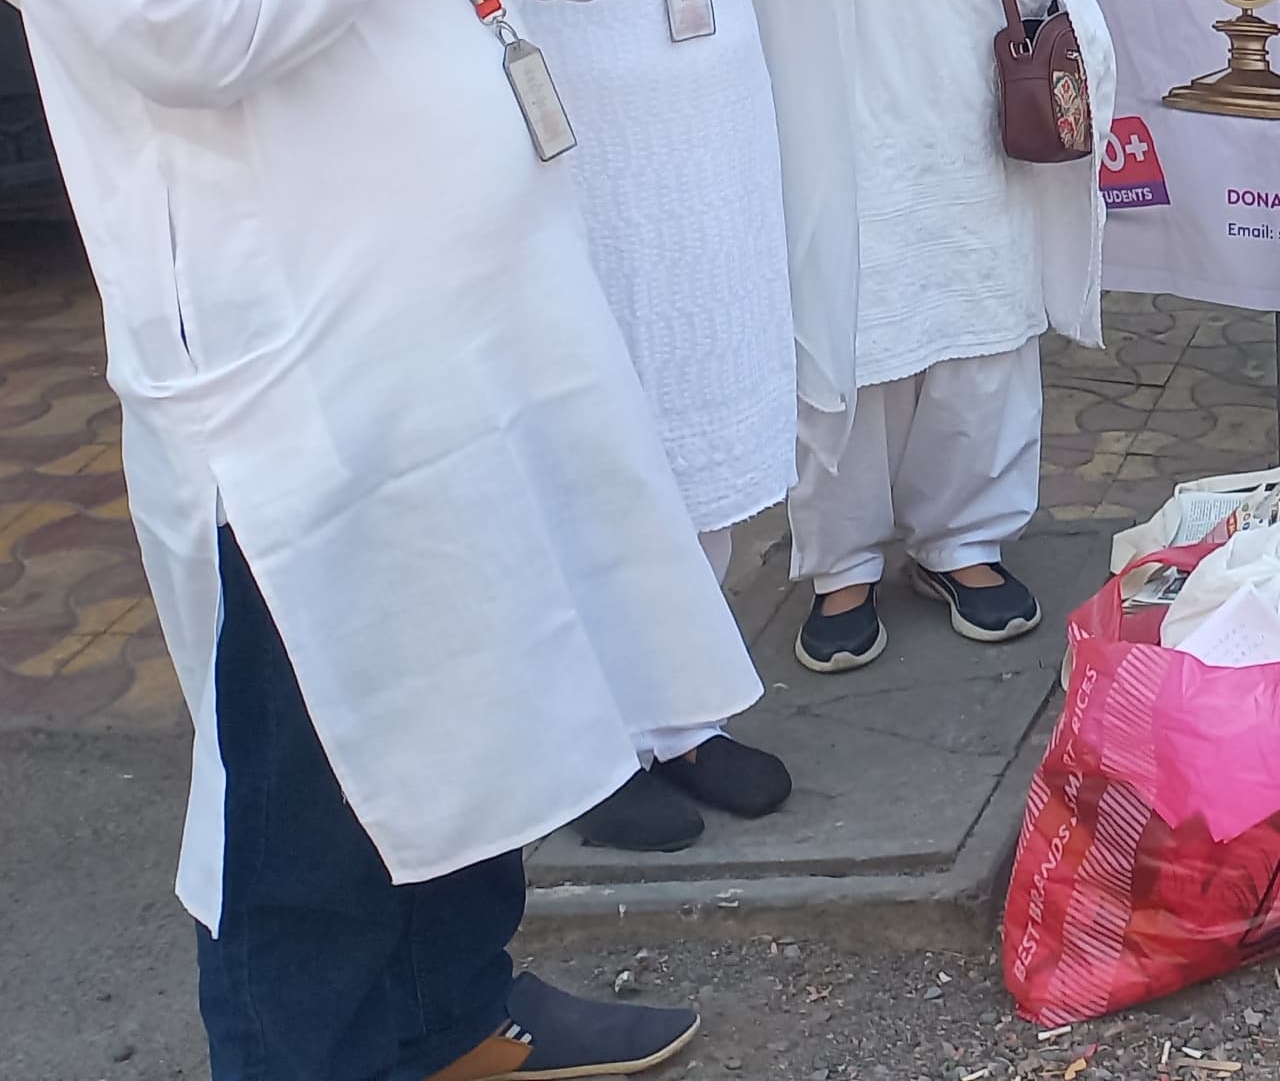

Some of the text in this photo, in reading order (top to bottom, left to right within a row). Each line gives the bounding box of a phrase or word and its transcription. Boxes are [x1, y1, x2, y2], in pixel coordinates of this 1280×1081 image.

[1101, 134, 1149, 171] 0+
[1228, 223, 1274, 240] Email:
[1026, 823, 1071, 927] BRANDS
[1013, 922, 1041, 983] BEST
